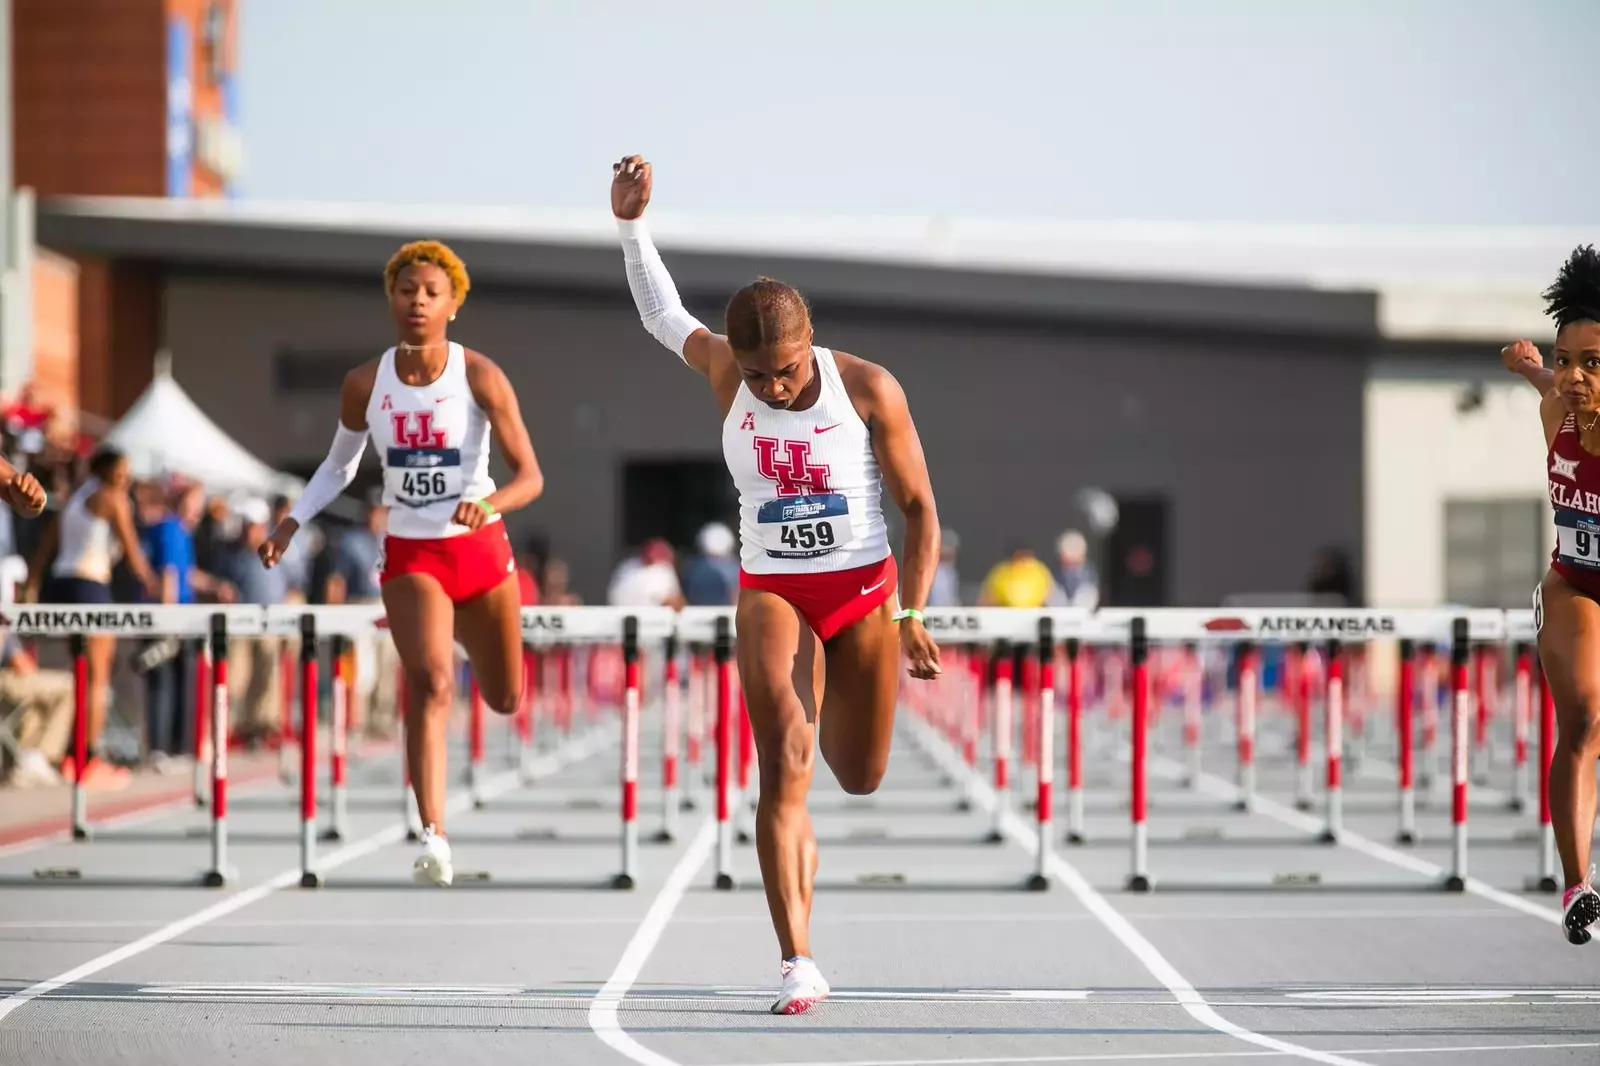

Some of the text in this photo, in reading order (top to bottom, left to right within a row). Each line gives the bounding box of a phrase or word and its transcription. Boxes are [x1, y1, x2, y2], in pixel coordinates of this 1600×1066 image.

[753, 436, 834, 497] UH
[402, 472, 446, 496] 456
[1549, 479, 1600, 515] KLAH
[781, 521, 835, 549] 459
[17, 611, 154, 631] ARKANSAS
[1259, 616, 1396, 633] ARKANSAS
